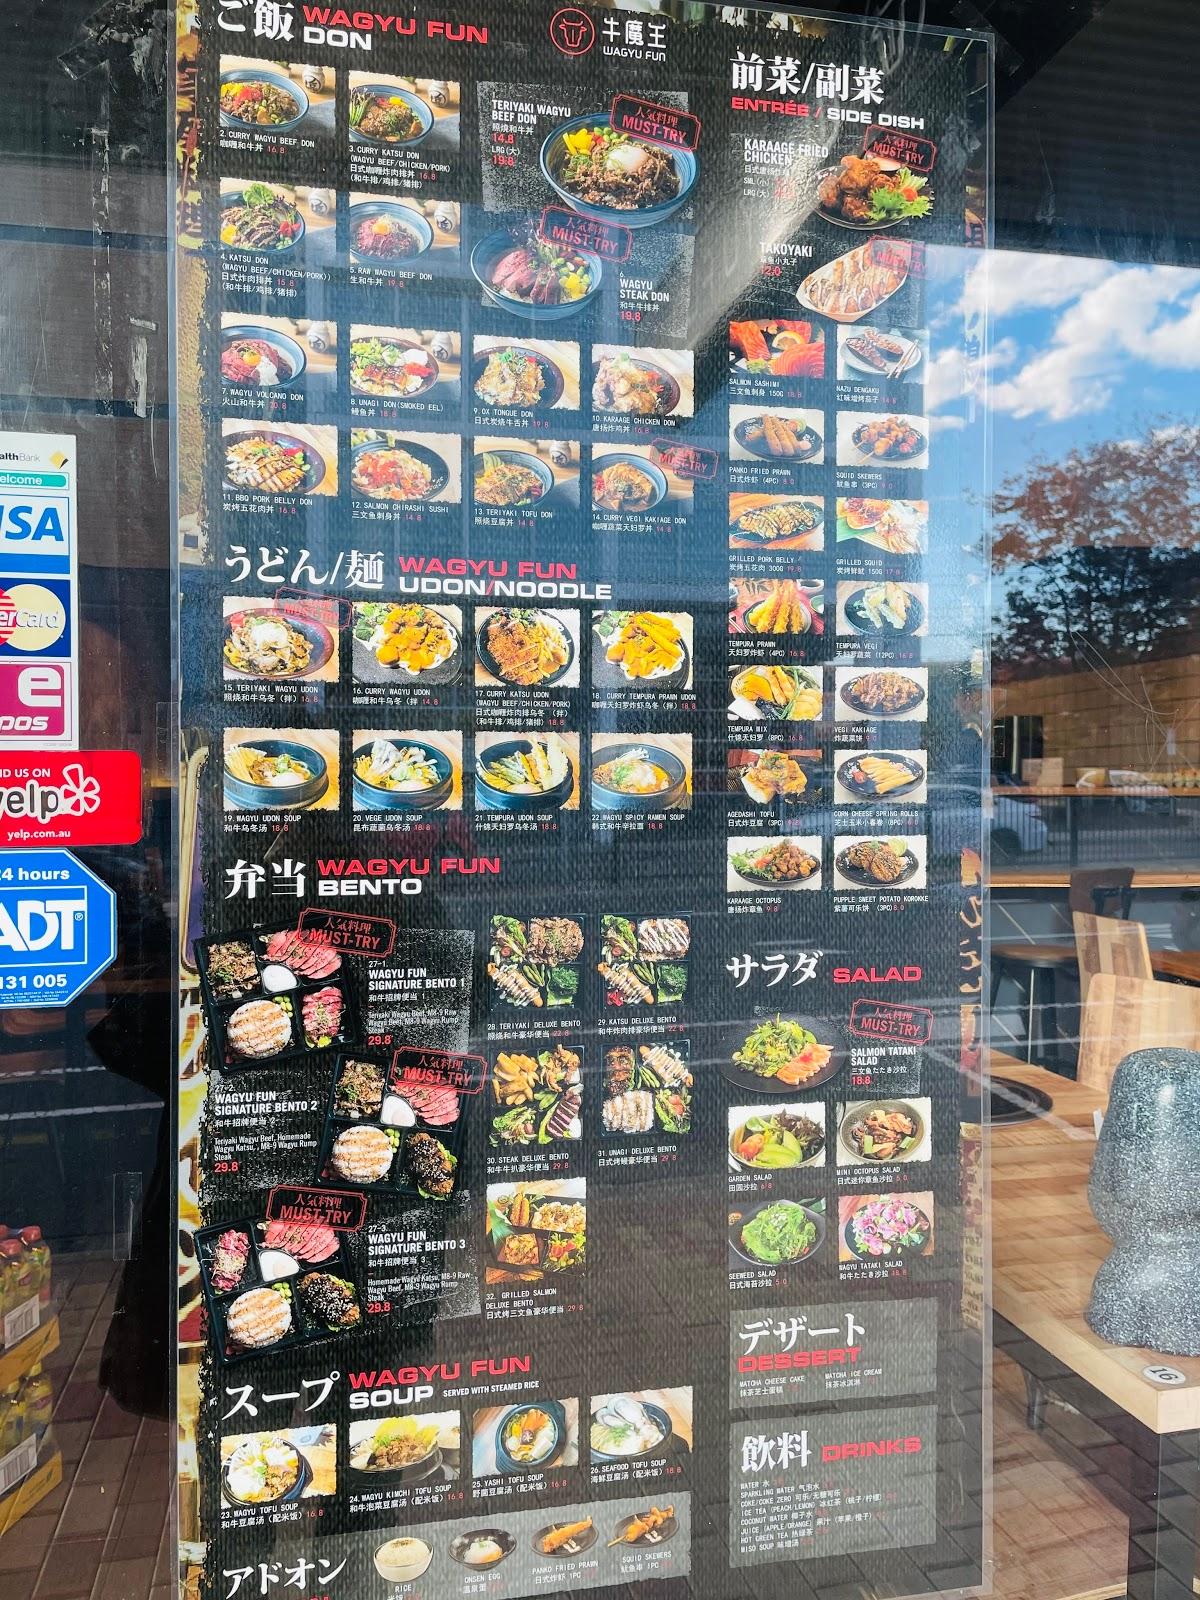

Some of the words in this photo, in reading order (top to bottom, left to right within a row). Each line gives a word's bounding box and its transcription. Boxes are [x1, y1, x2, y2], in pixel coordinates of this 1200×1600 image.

[303, 6, 416, 35] WAGYU
[427, 21, 488, 44] FUN
[603, 17, 666, 48] 牛魔王
[304, 27, 371, 50] DON
[603, 46, 642, 59] WAGYU
[646, 51, 666, 61] FUN
[730, 47, 884, 105] 前菜/副菜
[492, 100, 534, 114] TERIYAKI
[537, 104, 571, 117] WAGYU
[731, 97, 809, 116] ENTRÉE
[827, 108, 872, 124] SIDE
[878, 114, 924, 130] DISH
[492, 112, 515, 123] BEEF
[518, 115, 537, 124] DON
[622, 114, 686, 144] MUST-TRY
[280, 136, 297, 145] BEEF
[301, 139, 315, 148] DON
[492, 132, 514, 143] 14.8
[382, 148, 404, 158] KATSU
[406, 150, 419, 159] DON
[744, 138, 794, 154] KARAAGE
[798, 143, 829, 158] FRIED
[873, 141, 924, 164] MUST-TRY
[744, 152, 792, 166] CHICKEN
[553, 225, 618, 254] MUST-TRY
[760, 242, 813, 258] TAKOYAKI
[419, 273, 432, 281] DON
[620, 279, 653, 291] WAGYU
[620, 289, 648, 300] STEAK
[651, 291, 670, 302] DON
[256, 391, 286, 400] VOLCANO
[494, 409, 518, 417] TONGUE
[521, 410, 534, 418] DON
[252, 495, 270, 503] PORK
[275, 497, 296, 505] BELLY
[300, 497, 313, 505] DON
[429, 505, 449, 513] SUSHI
[521, 510, 538, 518] TOFU
[225, 545, 385, 589] うどん/麺
[399, 556, 507, 576] WAGYU
[517, 562, 577, 580] FUN
[399, 576, 612, 600] UDON/NOODLE
[729, 640, 754, 648] TEMPURA
[14, 769, 29, 778] US
[32, 768, 51, 778] ON
[0, 783, 59, 820] elp
[7, 829, 71, 841] yelp.com.au
[0, 868, 14, 881] 4
[18, 867, 70, 880] hours
[318, 858, 430, 876] WAGYU
[441, 858, 500, 874] FUN
[224, 859, 307, 899] 弁当
[318, 878, 422, 896] BENTO
[308, 927, 381, 950] MUST-TRY
[369, 968, 404, 979] WAGYU
[408, 968, 426, 978] FUN
[726, 950, 824, 988] サラダ
[833, 967, 922, 983] SALAD
[33, 973, 67, 988] 005
[369, 979, 422, 991] SIGNATURE
[426, 978, 457, 989] BENTO
[460, 978, 464, 988] 1
[861, 1017, 921, 1036] MUST-TRY
[368, 1034, 392, 1046] 29.8
[851, 1048, 886, 1057] SALMON
[888, 1046, 916, 1055] TATAKI
[851, 1057, 877, 1066] SALAD
[403, 1066, 472, 1087] MUST-TRY
[214, 1091, 253, 1104] WAGYU
[256, 1090, 276, 1102] FUN
[214, 1103, 272, 1116] SIGNATURE
[275, 1101, 307, 1112] BENTO
[311, 1101, 317, 1111] 2
[214, 1162, 238, 1173] 29.8
[728, 1174, 750, 1182] GARDEN
[280, 1205, 352, 1224] MUST-TRY
[368, 1232, 404, 1244] WAGYU
[407, 1230, 427, 1241] FUN
[368, 1243, 422, 1256] SIGNATURE
[425, 1240, 456, 1251] BENTO
[459, 1239, 466, 1248] 3
[502, 1290, 530, 1299] GRILLED
[368, 1302, 391, 1313] 29.8
[486, 1301, 509, 1310] DELUXE
[513, 1300, 534, 1308] BENTO
[739, 1313, 865, 1356] デザート
[738, 1346, 861, 1373] DESSERT
[349, 1362, 460, 1390] WAGYU
[471, 1355, 531, 1377] FUN
[1149, 1368, 1178, 1380] 16
[221, 1370, 340, 1421] スープ
[350, 1385, 434, 1410] SOUP
[443, 1387, 470, 1398] SERVED
[471, 1385, 489, 1395] WITH
[491, 1382, 523, 1392] STEAMED
[741, 1430, 812, 1473] 飲料
[822, 1436, 922, 1463] DRINKS
[632, 1461, 648, 1469] TOFU
[651, 1459, 666, 1467] SOUP
[508, 1475, 524, 1484] TOFU
[528, 1473, 544, 1482] SOUP
[415, 1486, 432, 1495] TOFU
[435, 1485, 451, 1493] SOUP
[259, 1505, 277, 1514] TOFU
[280, 1503, 298, 1512] SOUP
[222, 1557, 347, 1600] アドオン
